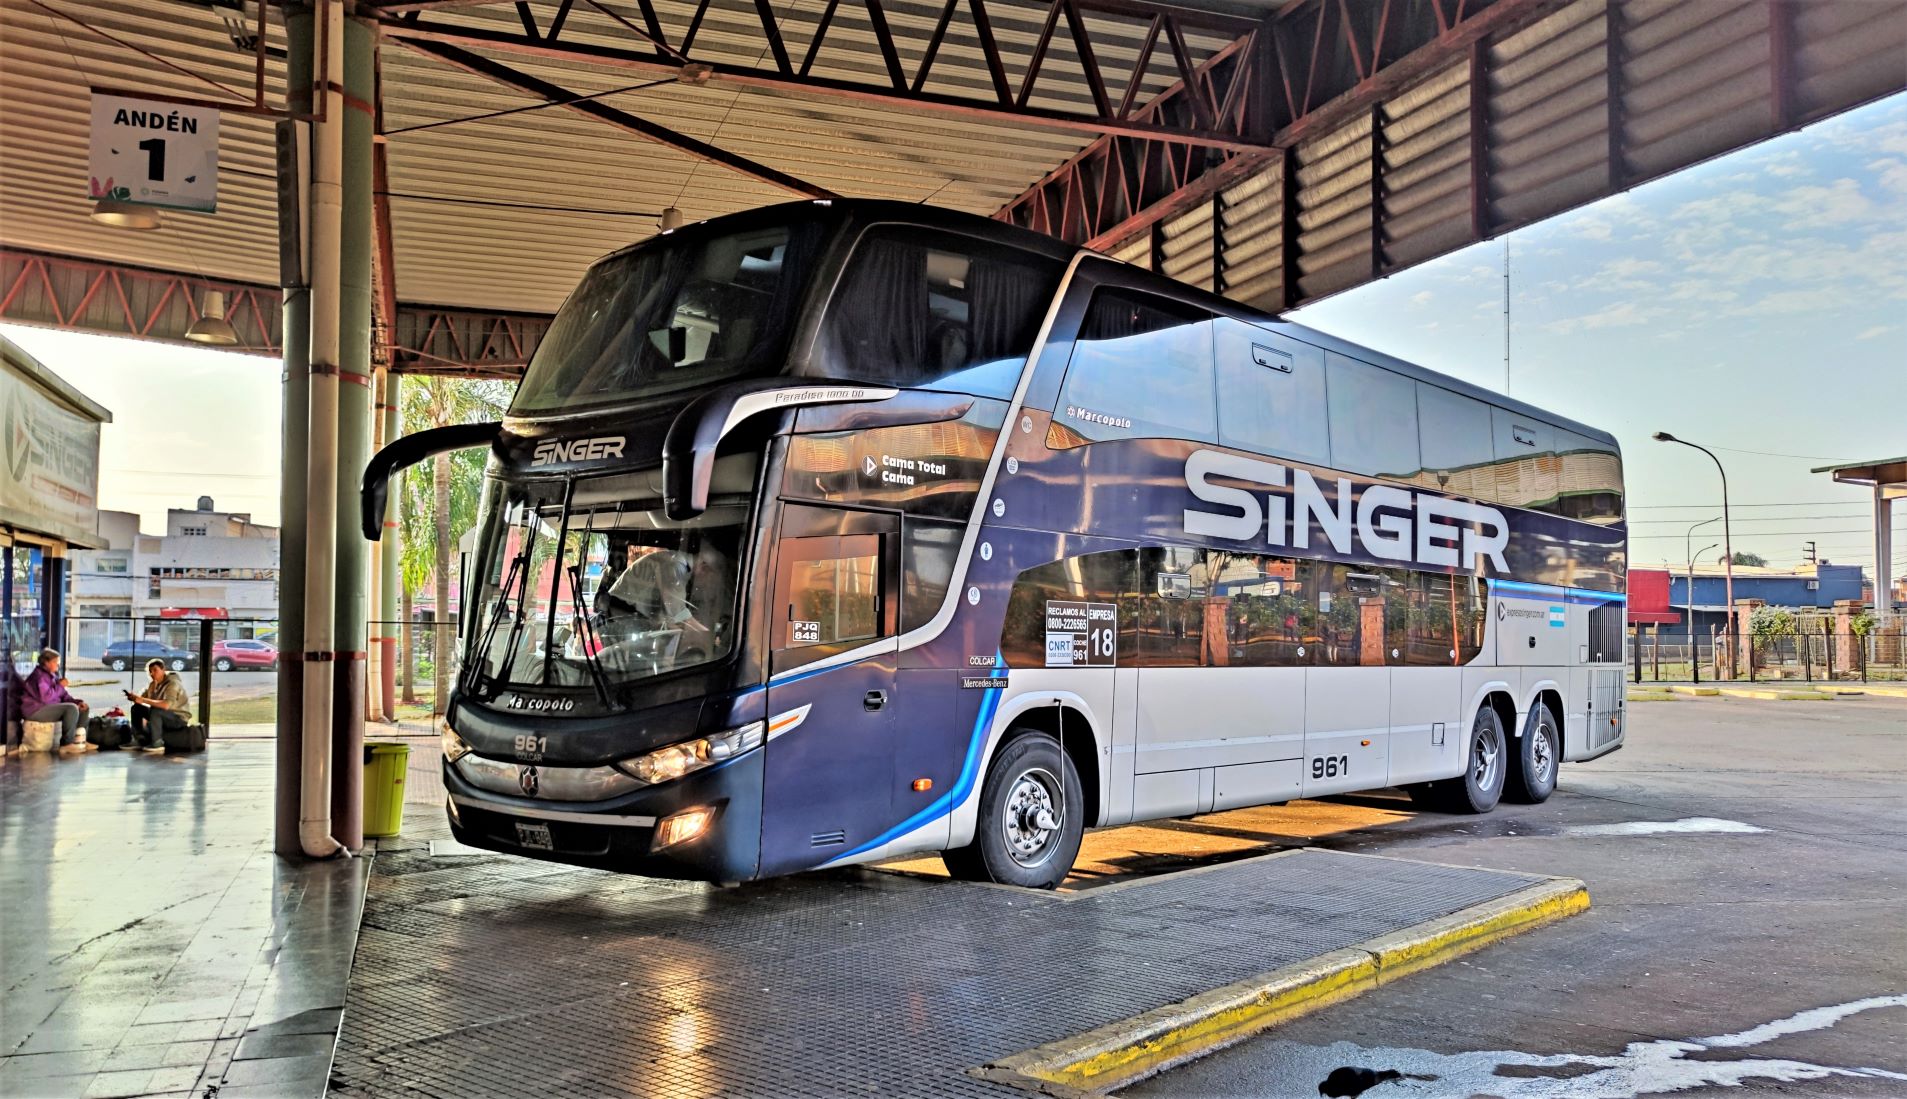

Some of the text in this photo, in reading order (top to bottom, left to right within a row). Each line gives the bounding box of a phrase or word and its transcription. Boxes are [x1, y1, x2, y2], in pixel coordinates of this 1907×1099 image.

[113, 108, 198, 135] ANDÉN
[139, 138, 166, 182] 1
[775, 390, 824, 404] Paradiso
[1076, 407, 1131, 428] Marcopolo
[530, 436, 626, 467] SINGER
[881, 454, 946, 476] Cama Total
[881, 470, 915, 486] Cama
[1183, 449, 1512, 574] SINGER
[1047, 607, 1087, 617] RECLAMOS AL
[1089, 608, 1115, 621] EMPRESA
[794, 623, 818, 631] PJQ
[794, 631, 818, 640] 848
[1091, 628, 1114, 657] 18
[1048, 640, 1071, 651] CNRT
[969, 656, 996, 666] COLCAR
[1073, 649, 1087, 660] 961
[963, 678, 1008, 688] Mercedes-Benz
[514, 734, 547, 753] 961
[1312, 755, 1348, 779] 961
